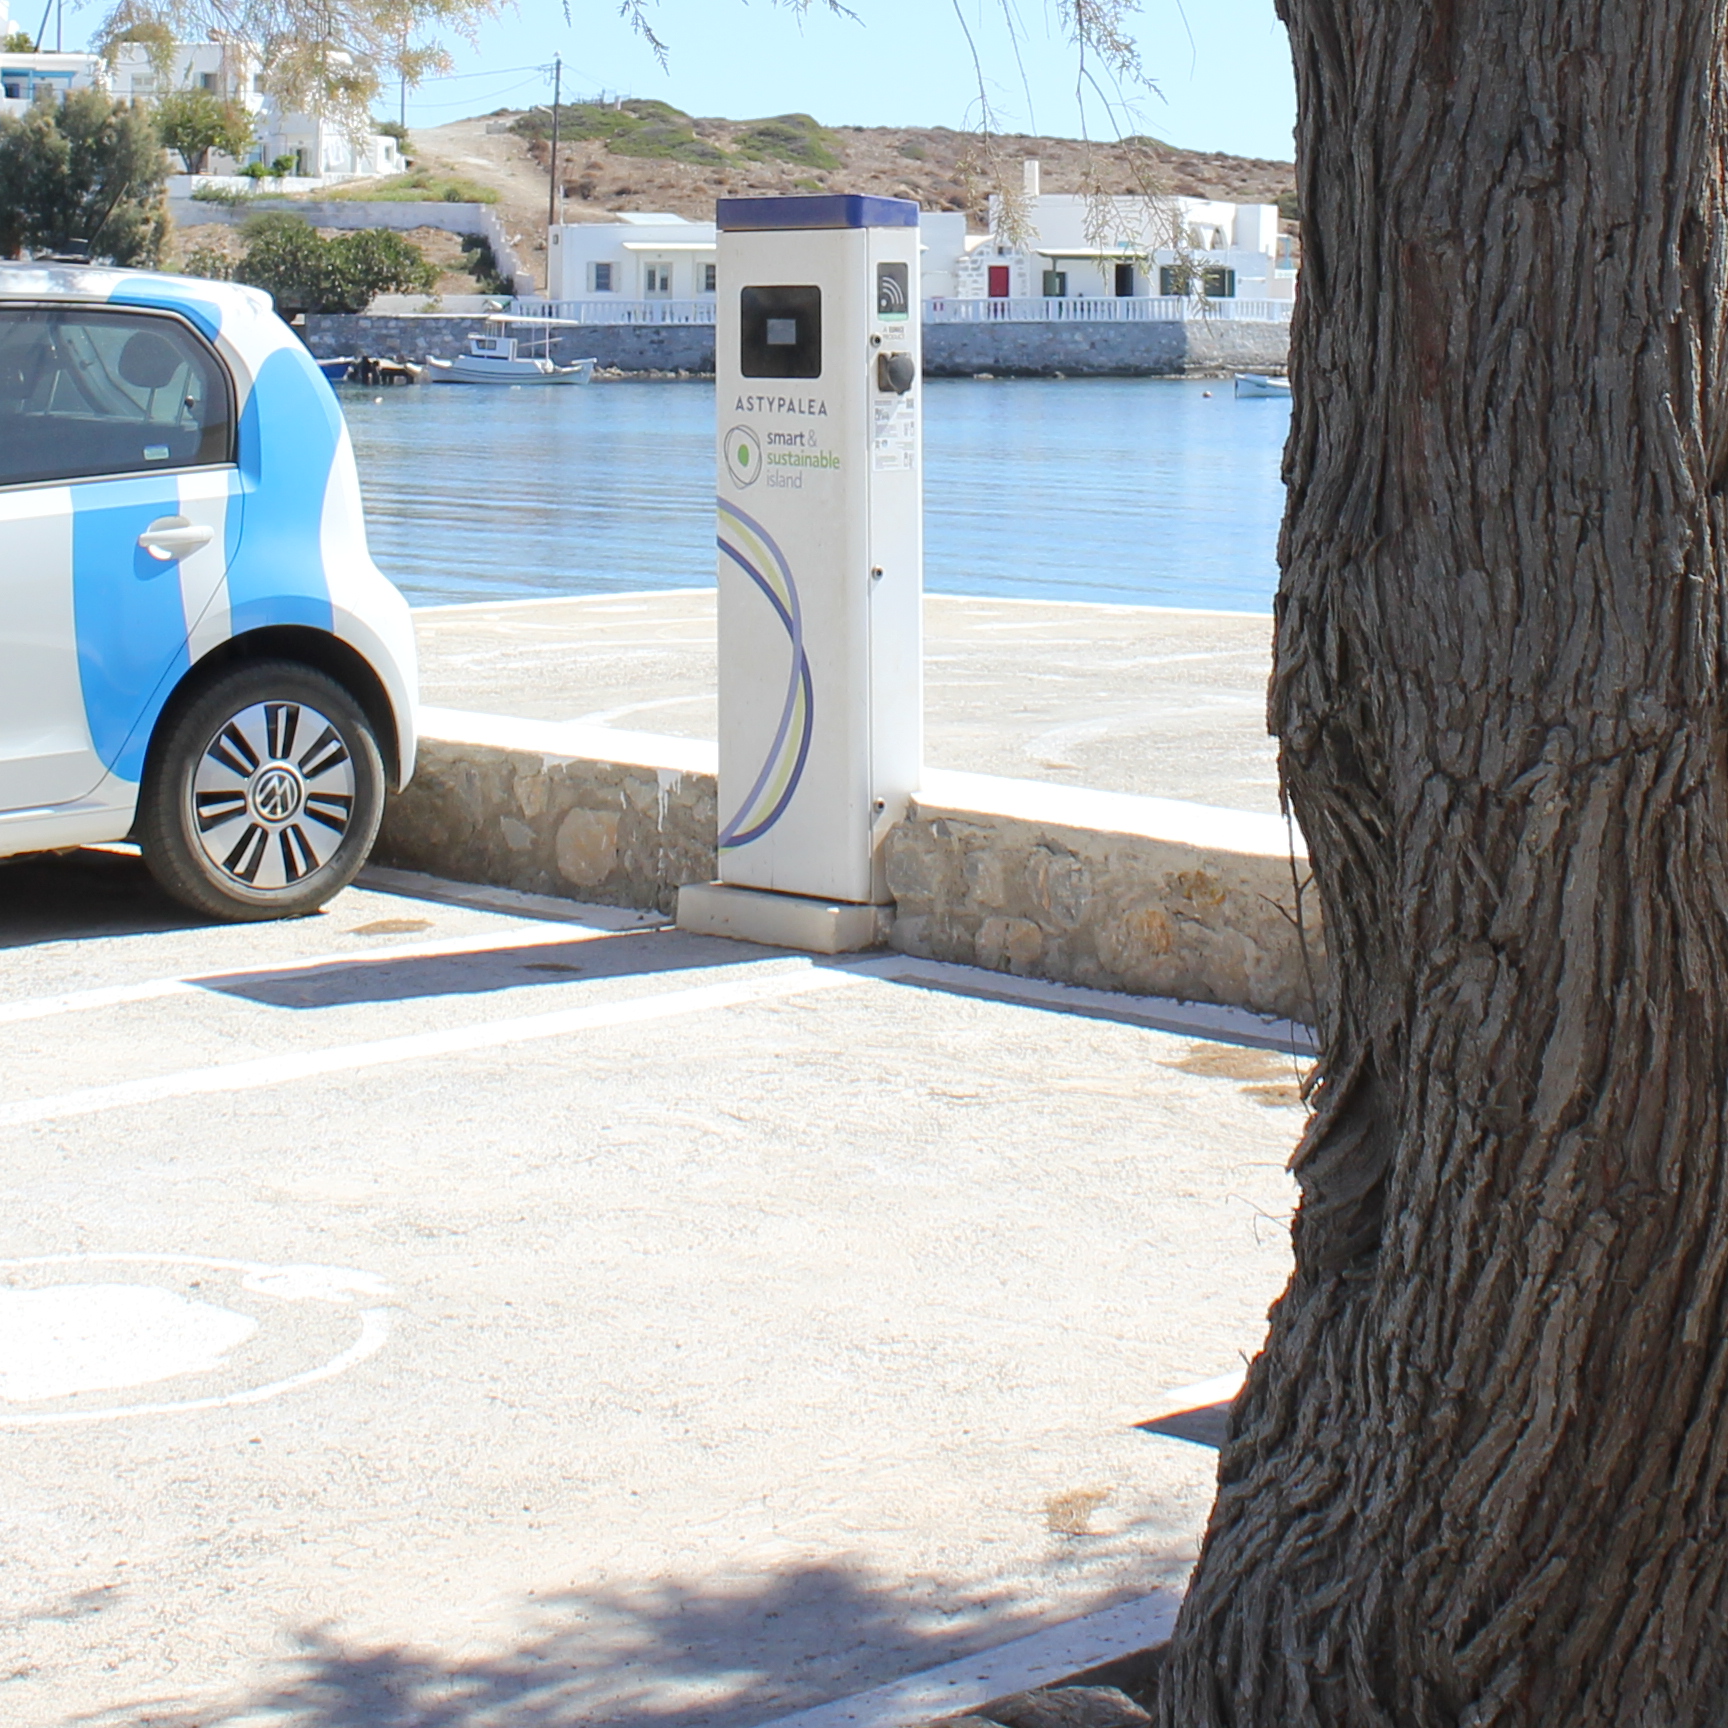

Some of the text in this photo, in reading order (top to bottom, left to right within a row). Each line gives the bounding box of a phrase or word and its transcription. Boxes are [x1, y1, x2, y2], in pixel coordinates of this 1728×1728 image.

[735, 395, 828, 417] ASTYPALEA
[766, 428, 817, 447] smart &
[766, 450, 840, 469] sustainable
[766, 469, 802, 489] island
